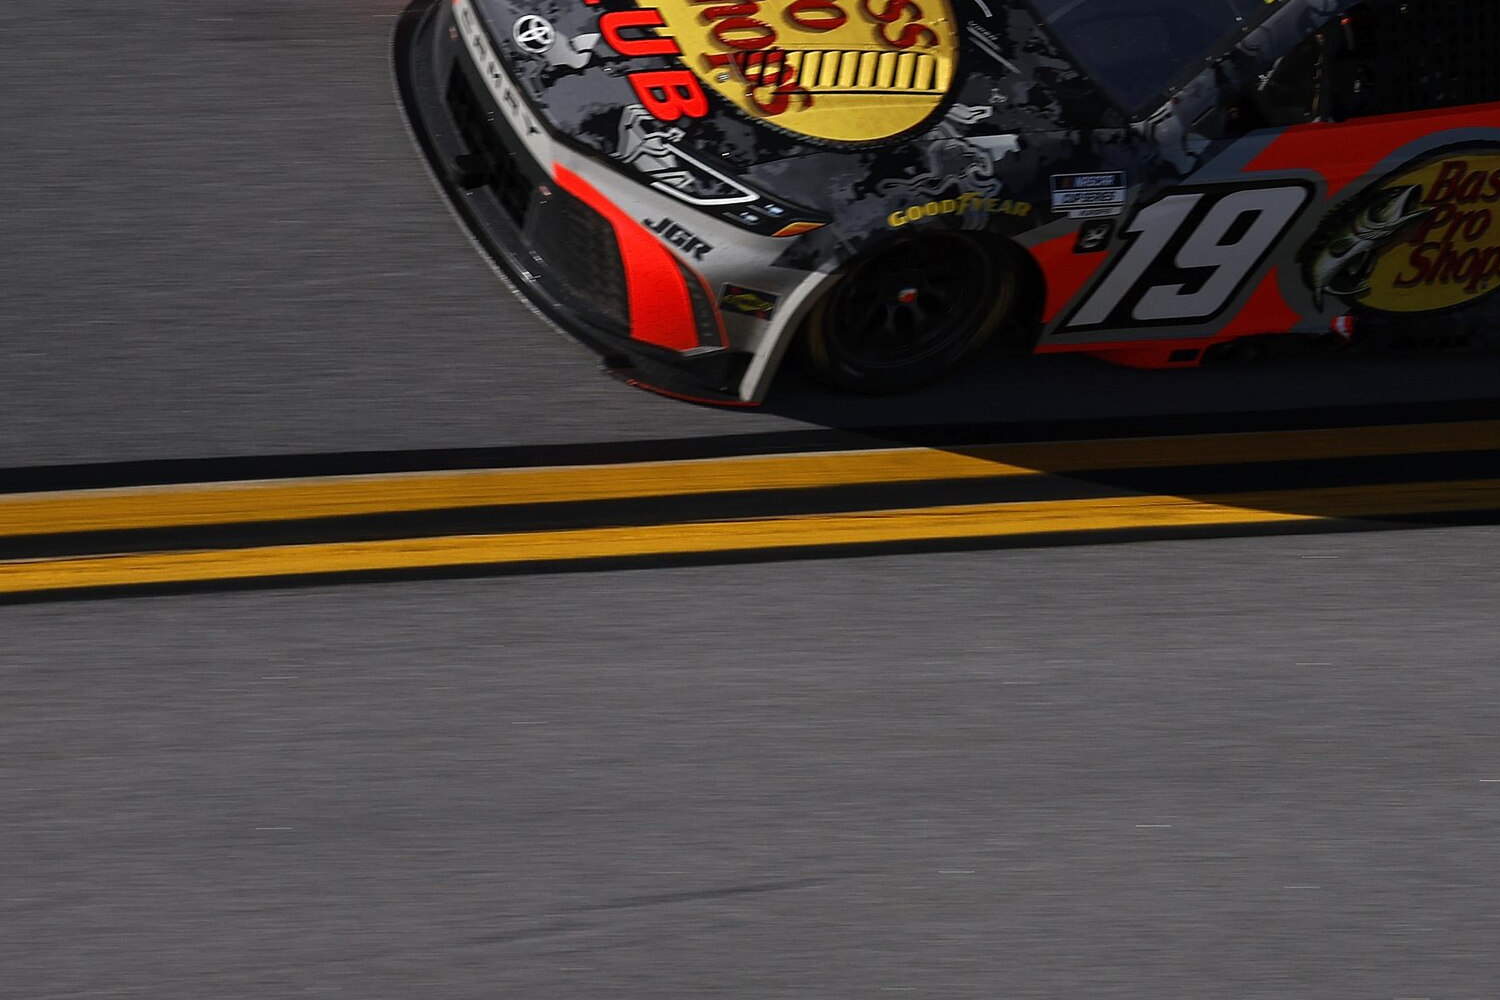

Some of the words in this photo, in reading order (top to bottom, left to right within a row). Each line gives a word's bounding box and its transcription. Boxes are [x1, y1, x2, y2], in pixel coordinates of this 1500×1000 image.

[886, 192, 1033, 228] GOODYEAR
[1411, 203, 1492, 246] Pro
[643, 216, 714, 262] JGR
[1066, 185, 1309, 328] 19
